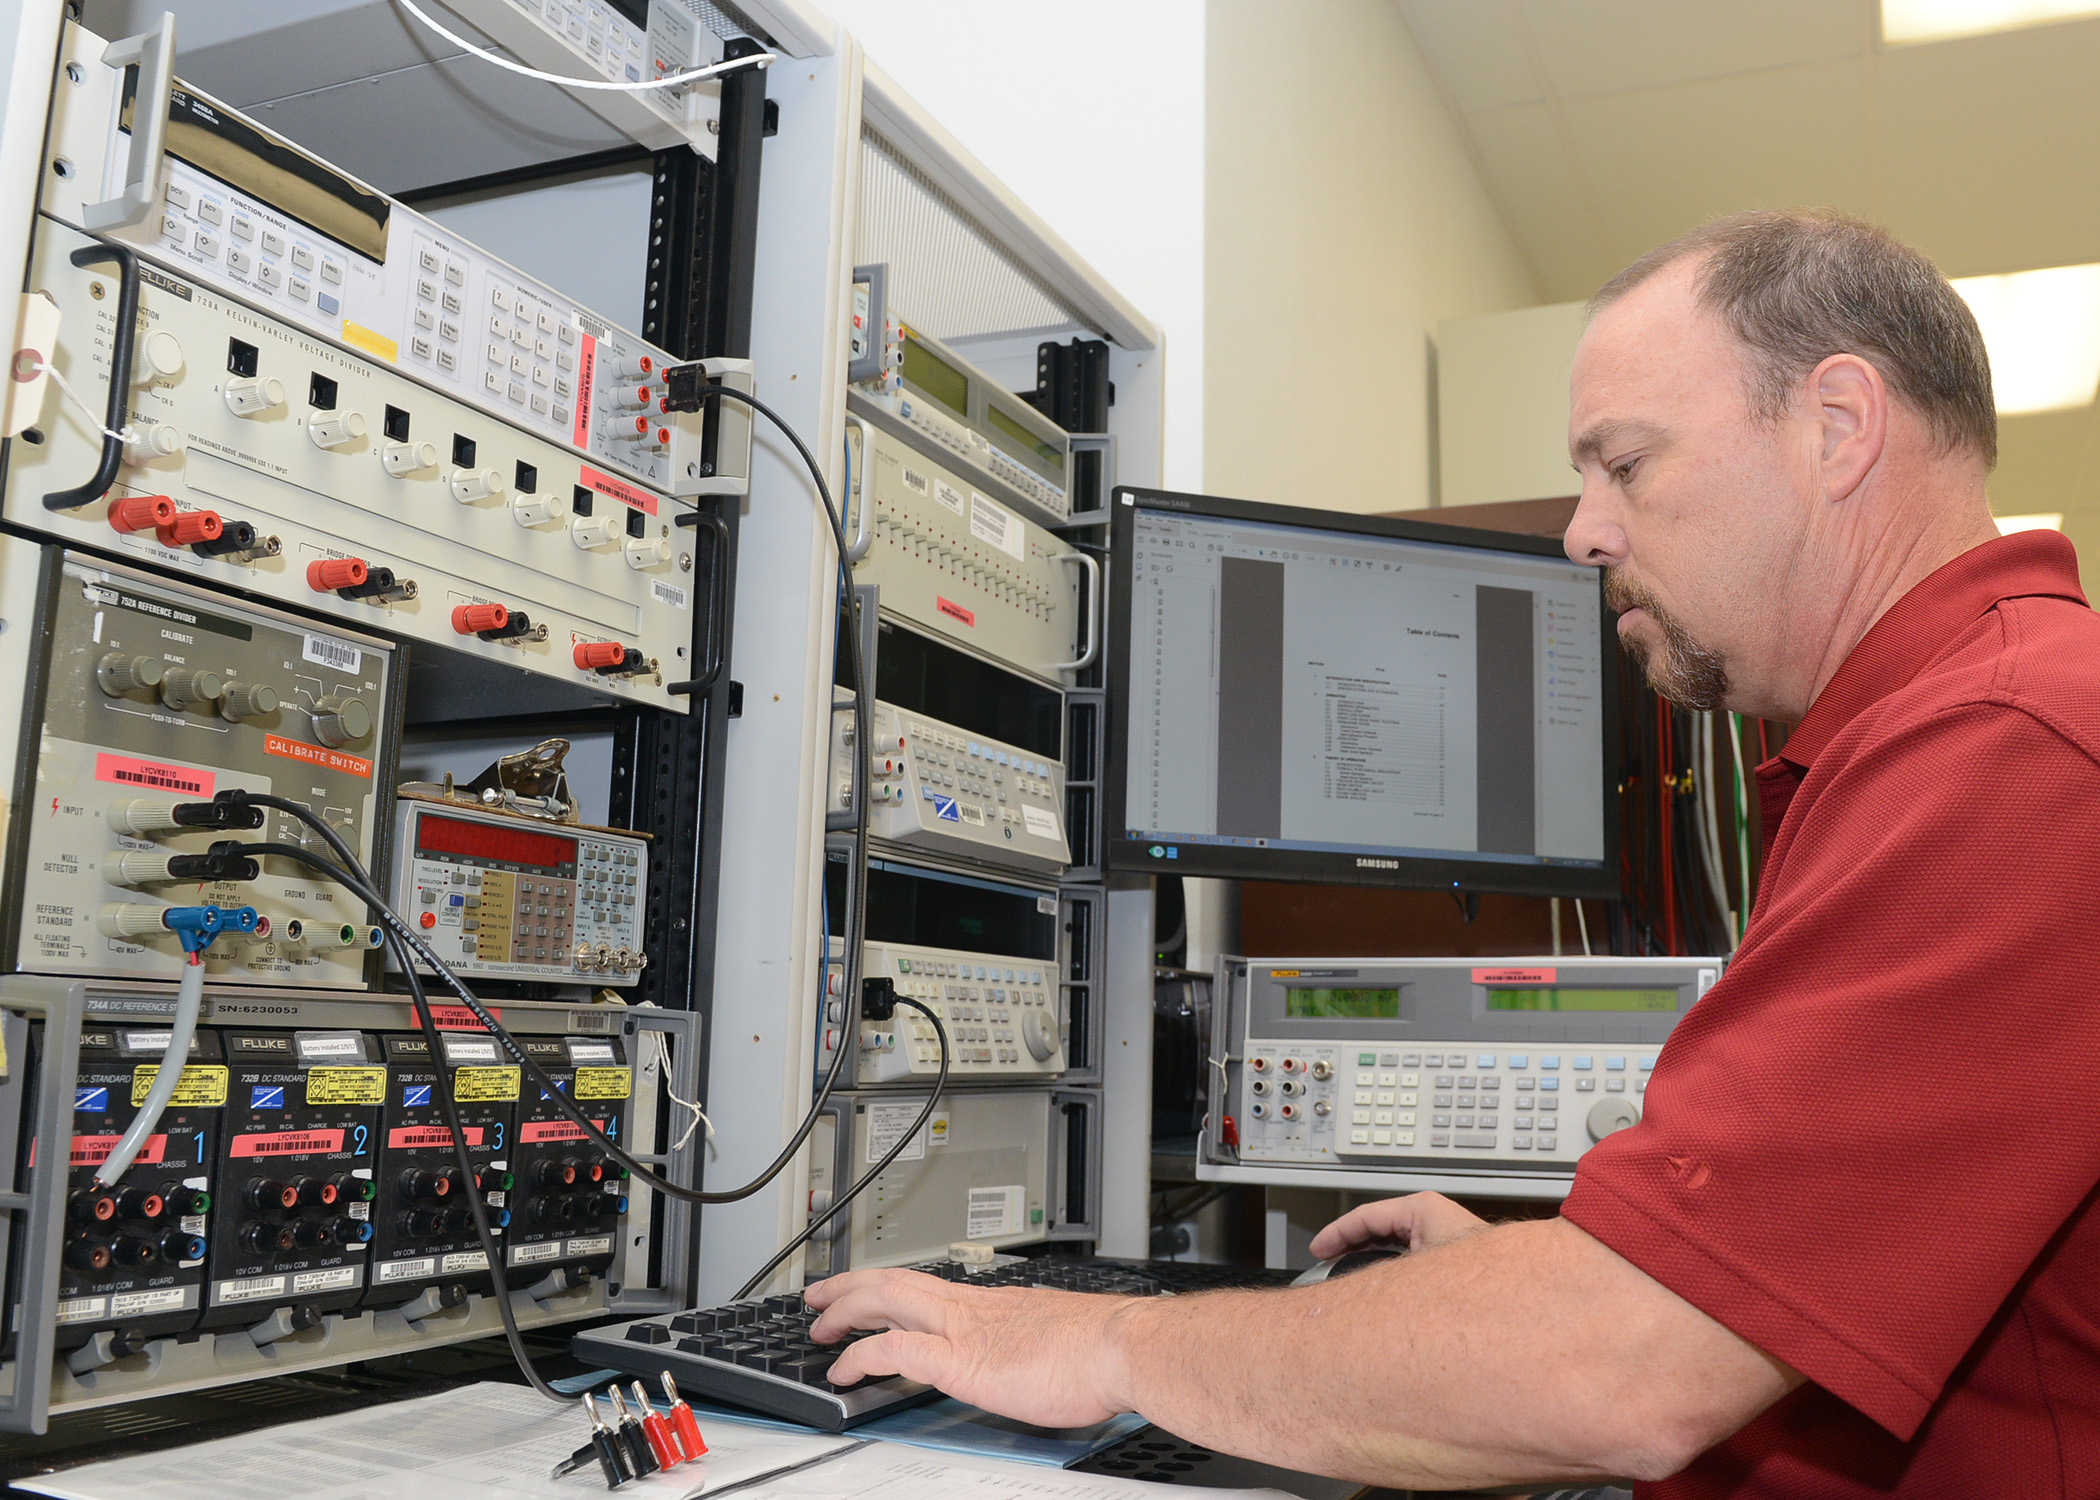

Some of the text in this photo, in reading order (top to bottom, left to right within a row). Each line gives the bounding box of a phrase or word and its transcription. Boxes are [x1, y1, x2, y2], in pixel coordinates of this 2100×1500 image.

[170, 185, 183, 196] DCV
[204, 204, 216, 213] ACV
[183, 213, 199, 225] Range
[230, 197, 287, 231] FUNCTION/RANGE
[236, 219, 249, 229] OHM
[266, 234, 277, 243] DCI
[435, 240, 450, 252] MENU
[170, 243, 204, 264] Menu Scroll
[325, 264, 338, 275] FREQ
[138, 306, 160, 321] NCTION
[197, 296, 372, 379] 720A KELVIN-VARLEY VOLTAGE DIVIDER
[214, 385, 219, 393] A
[297, 418, 302, 426] B
[188, 433, 197, 442] FOR
[198, 436, 220, 450] READINGS
[221, 443, 236, 454] ABOVE
[257, 458, 266, 467] USE
[274, 463, 288, 475] INPUT
[173, 498, 192, 511] INPUT
[121, 596, 197, 624] 752A REFERENCE DIVIDER
[161, 629, 194, 645] CALIBRATE
[1407, 628, 1423, 636] Table
[1433, 631, 1460, 640] Contents
[164, 653, 185, 665] BALANCE
[279, 701, 298, 711] OPERATE
[269, 740, 367, 773] CALIBRATE SWITCH
[140, 765, 177, 778] LYCVK8110
[311, 787, 327, 797] MODE
[63, 805, 84, 816] INPUT
[61, 854, 79, 864] NULL
[1356, 858, 1399, 869] SAMSUNG
[44, 863, 78, 874] DETECTOR
[213, 883, 237, 892] OUTPUT
[284, 890, 333, 902] GROUND GUARD
[36, 905, 74, 916] REFERENCE
[36, 916, 73, 927] STANDARD
[45, 935, 71, 943] FLOATING
[40, 941, 70, 950] TERMINALS
[256, 957, 275, 965] CONNECT
[247, 963, 291, 972] PROTECTIVE GROUND
[87, 1001, 108, 1010] 734A
[109, 1001, 122, 1010] DC
[123, 1001, 166, 1012] REFERENCE
[218, 1004, 299, 1015] SN:6230053
[79, 1035, 107, 1045] UKE
[129, 1036, 172, 1046] Battery Installe
[242, 1039, 287, 1049] FLUKE
[399, 1043, 429, 1051] FLUK
[527, 1044, 559, 1052] FLUKE
[77, 1074, 132, 1084] DC STANDARD
[240, 1074, 307, 1083] 732B DC STANDARD
[397, 1074, 413, 1082] 732B
[415, 1074, 424, 1082] DC
[606, 1115, 618, 1142] 4
[353, 1124, 368, 1156] 2
[492, 1122, 504, 1150] 3
[193, 1131, 205, 1163] 1
[469, 1145, 490, 1153] CHASSIS
[252, 1156, 264, 1164] 10V
[291, 1154, 309, 1162] 1.018V
[327, 1151, 352, 1160] CHASSIS
[157, 1160, 187, 1169] CHASSIS
[464, 1241, 482, 1249] GUARD
[403, 1249, 416, 1257] COM
[274, 1261, 309, 1271] 1.018V COM
[320, 1257, 342, 1266] GUARD
[235, 1265, 263, 1275] 10V COM
[149, 1276, 174, 1286] GUARD
[92, 1280, 134, 1293] 1.018V COM
